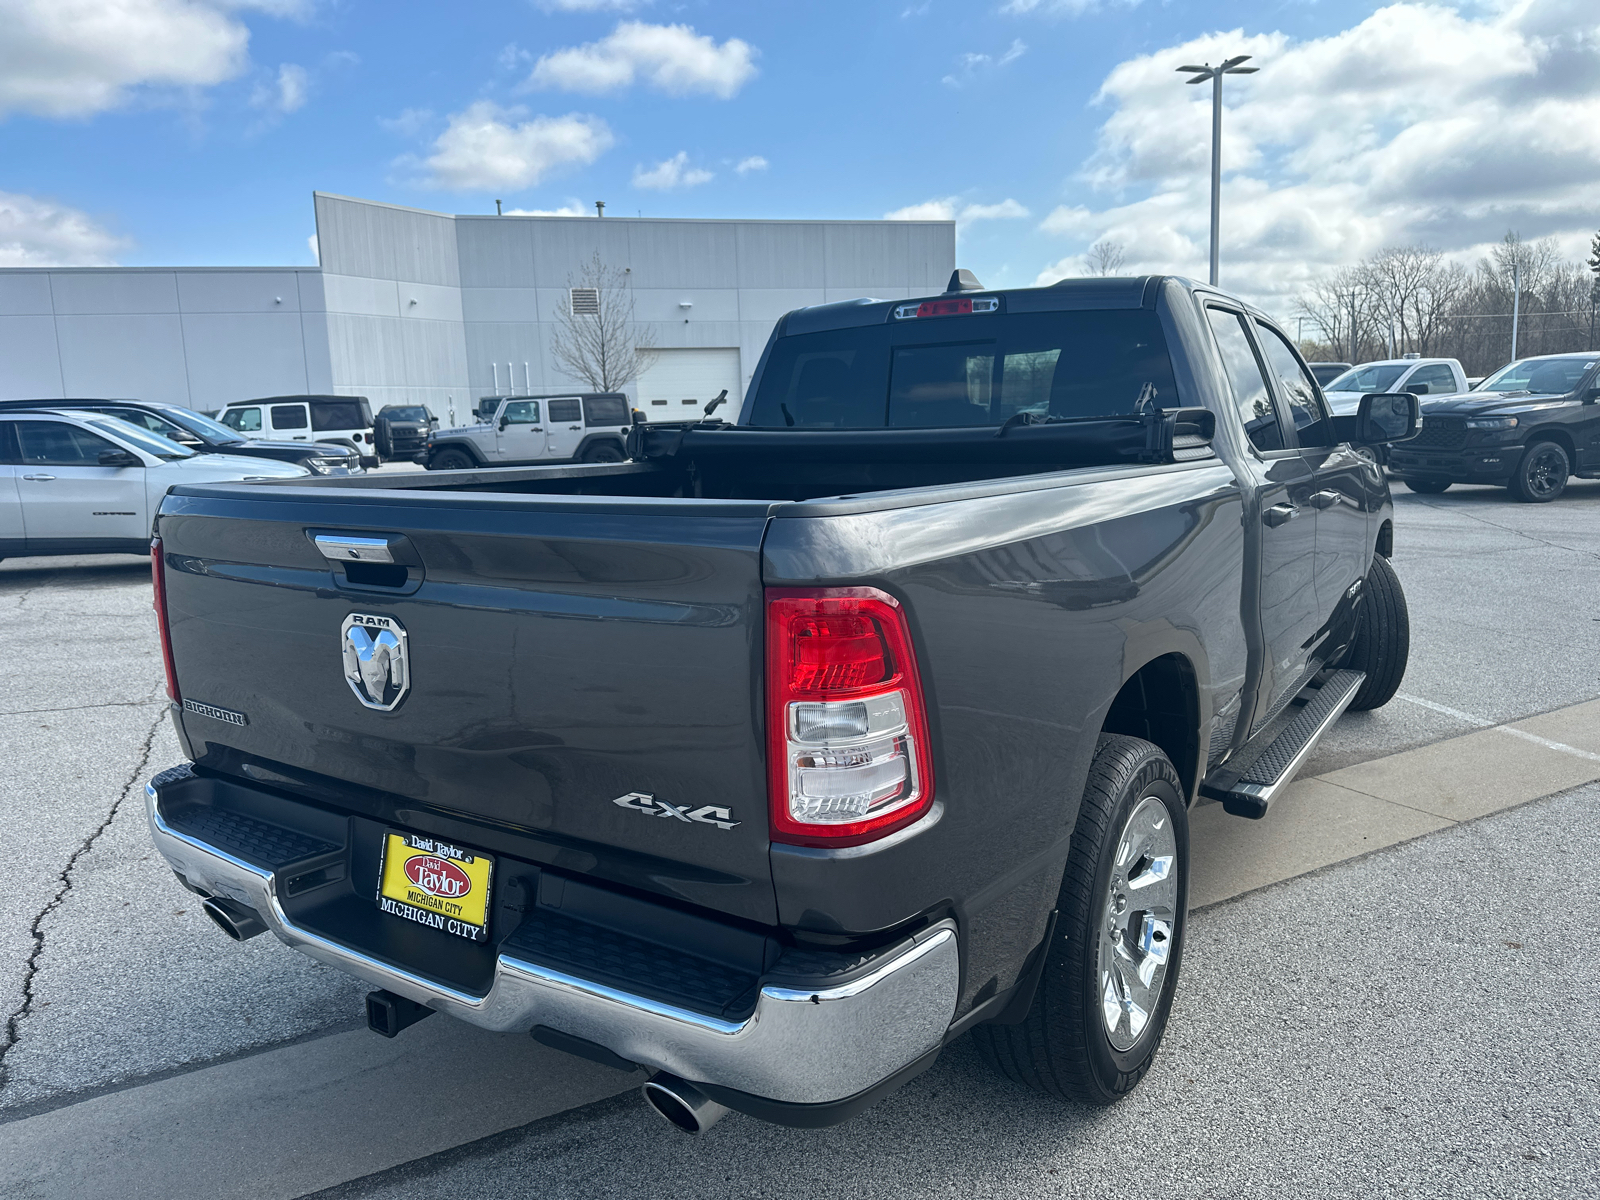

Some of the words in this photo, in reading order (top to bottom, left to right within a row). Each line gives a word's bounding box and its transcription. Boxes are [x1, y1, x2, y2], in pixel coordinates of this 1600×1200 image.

[353, 615, 390, 627] RAM
[184, 699, 245, 727] BIGHORN
[411, 835, 434, 852] David
[433, 841, 464, 860] Taylor
[421, 856, 441, 871] David
[414, 865, 464, 897] Taylor
[406, 890, 444, 912] MICHIGAN
[444, 902, 463, 916] CITY
[380, 897, 445, 930] MICHIGAN
[447, 919, 480, 941] CITY
